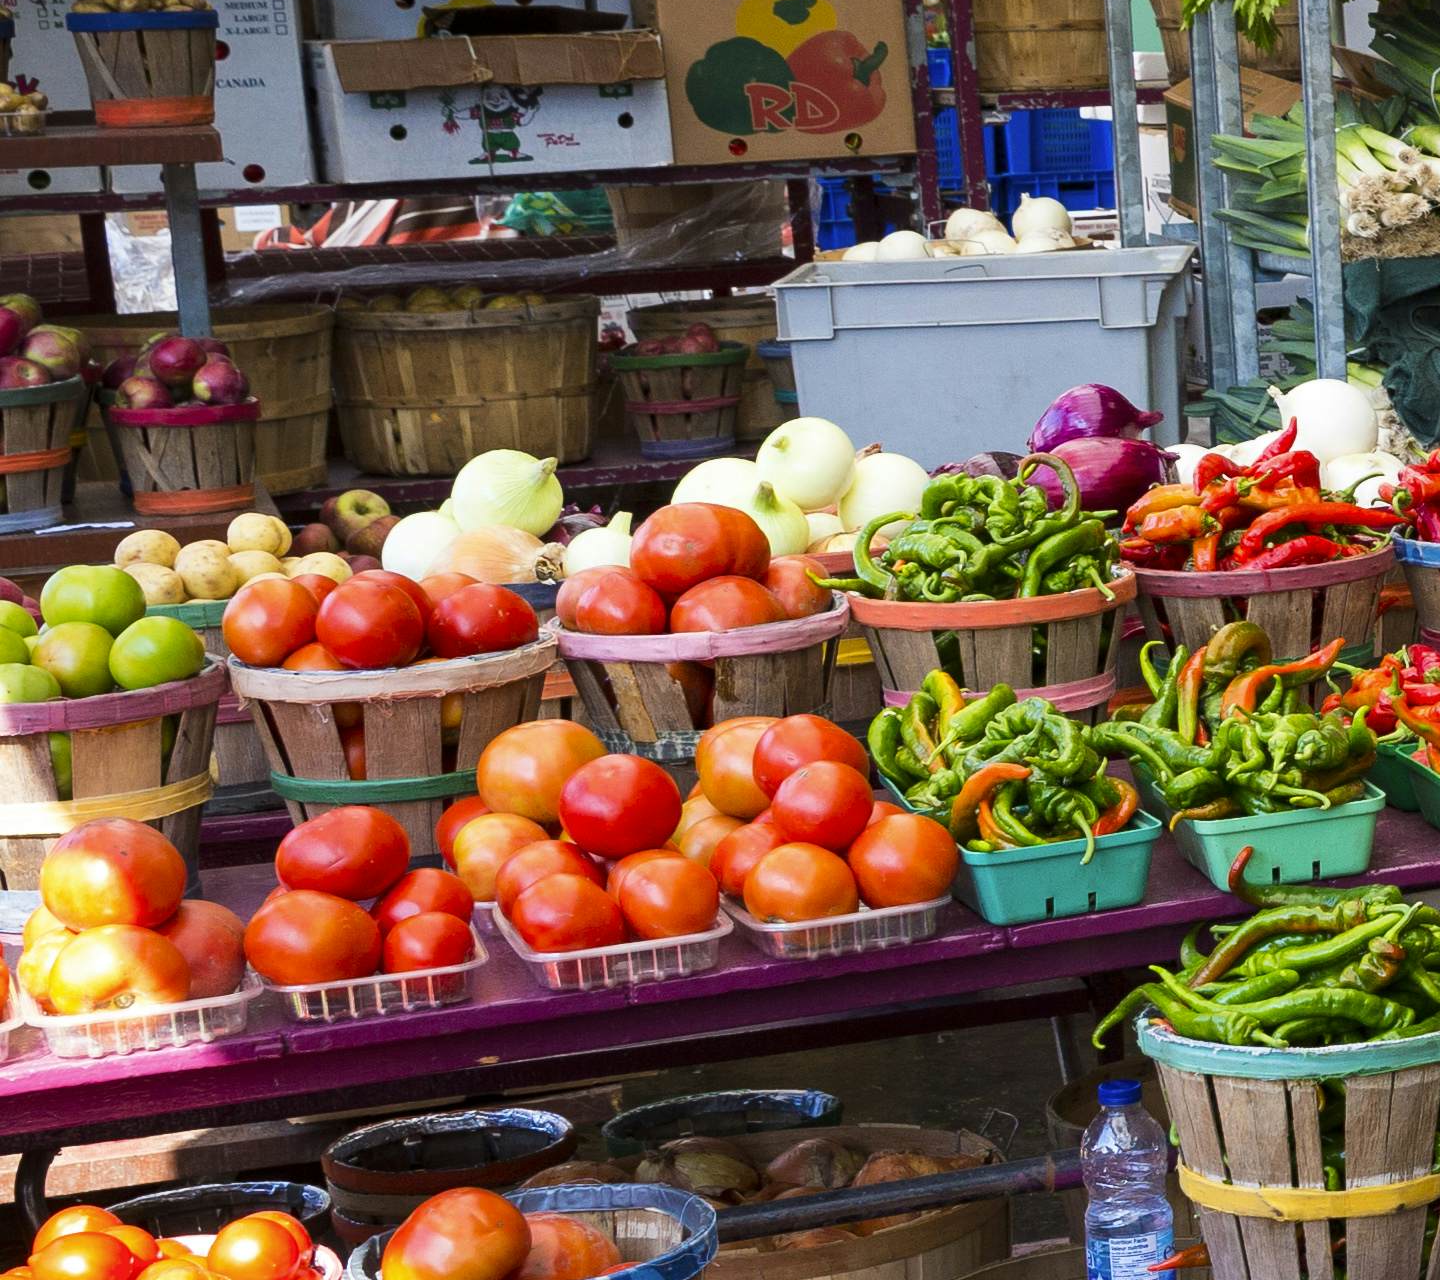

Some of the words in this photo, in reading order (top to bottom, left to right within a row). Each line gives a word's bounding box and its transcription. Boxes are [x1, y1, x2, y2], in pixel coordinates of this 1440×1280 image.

[225, 0, 268, 11] MEDIUM
[234, 13, 270, 23] LARGE
[225, 25, 271, 35] X-LARGE
[216, 77, 266, 89] CANADA
[743, 81, 840, 131] RD
